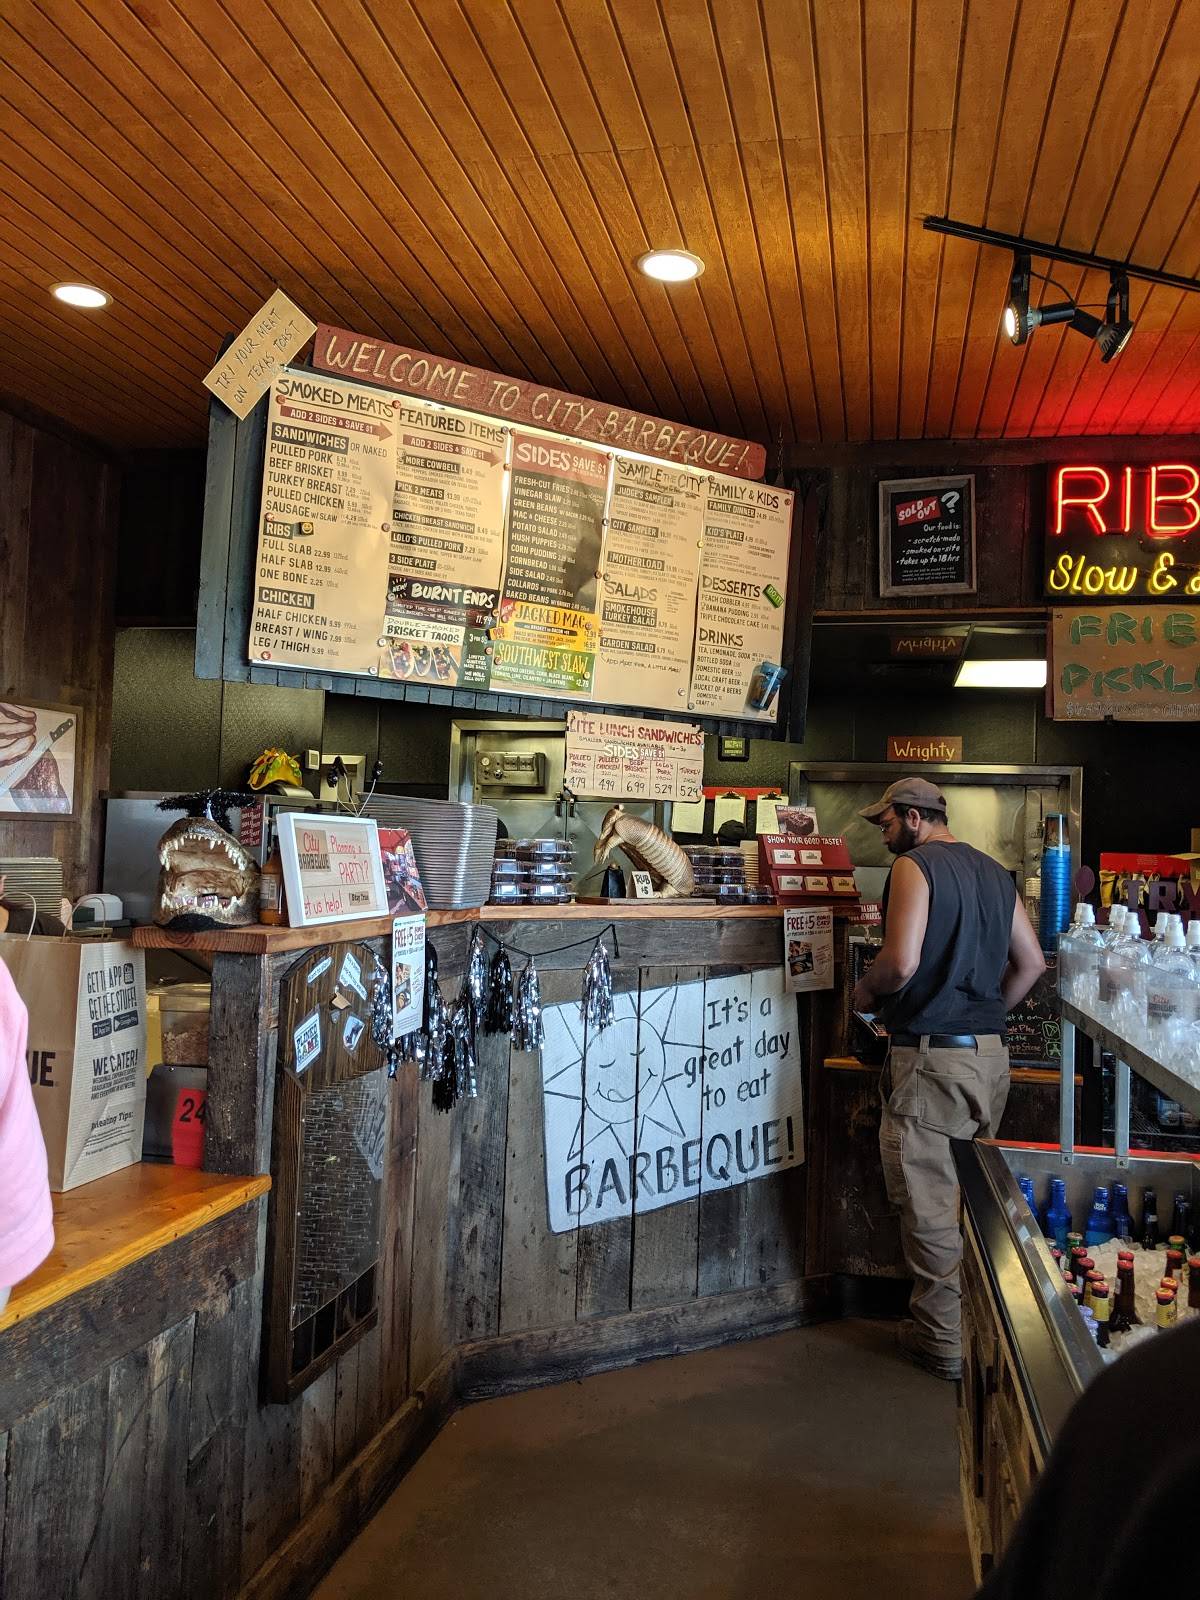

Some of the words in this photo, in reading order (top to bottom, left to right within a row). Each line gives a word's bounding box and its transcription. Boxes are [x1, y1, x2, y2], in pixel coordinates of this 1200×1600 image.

[215, 366, 236, 393] TRY
[234, 338, 260, 366] YOUR
[256, 308, 282, 338] MEAT
[234, 387, 247, 404] ON
[248, 354, 275, 386] TEXAS
[273, 320, 302, 352] TOAST
[276, 380, 343, 404] SMOKED
[347, 394, 393, 417] MEATS
[325, 335, 479, 398] WELCOME
[488, 380, 520, 412] TO
[532, 393, 594, 432] CITY
[599, 411, 749, 470] BARBEQUE!
[400, 408, 466, 433] FEATURED
[469, 421, 505, 444] ITEMS
[275, 425, 347, 449] SANDWICHES
[350, 442, 360, 453] OR
[362, 443, 387, 458] NAKED
[270, 443, 306, 458] PULLED
[309, 451, 333, 465] PORK
[405, 456, 426, 468] MORE
[427, 460, 459, 473] COWBELL
[516, 443, 571, 472] SIDES
[572, 455, 595, 473] SAVE
[597, 462, 606, 475] $1
[268, 471, 305, 487] TURKEY
[307, 479, 343, 495] BREAST
[514, 475, 551, 490] FRESH-CUT
[553, 482, 570, 494] FRIES
[617, 461, 663, 482] SAMPLE
[677, 474, 701, 492] CITY
[514, 487, 543, 500] VINEGAR
[545, 492, 562, 503] SLAW
[708, 481, 747, 500] FAMILY
[748, 490, 755, 500] &
[756, 490, 780, 509] KIDS
[265, 500, 310, 518] SAUSAGE
[320, 512, 338, 523] SLAW
[898, 500, 923, 521] SOLD
[917, 500, 937, 519] OUT
[266, 522, 291, 538] RIBS
[512, 520, 536, 533] POTATO
[538, 526, 558, 538] SALAD
[612, 520, 626, 530] CITY
[627, 523, 657, 536] SAMPLER
[923, 523, 936, 532] Our
[937, 521, 953, 531] food
[262, 538, 285, 552] FULL
[288, 542, 312, 556] SLAB
[314, 549, 331, 558] 22.99
[906, 545, 932, 554] smoked
[933, 544, 960, 553] on-site
[913, 533, 960, 544] scratch-made
[510, 555, 547, 569] CORNBREAD
[900, 557, 919, 565] takes
[920, 557, 928, 565] up
[929, 555, 937, 563] to
[938, 554, 946, 562] 18
[947, 554, 960, 562] hrs
[1050, 555, 1137, 592] Slow
[1152, 552, 1178, 591] &
[507, 578, 540, 591] COLLARDS
[605, 581, 657, 601] SALADS
[702, 574, 760, 598] DESSERTS
[262, 589, 312, 608] CHICKEN
[411, 582, 463, 605] BURNT
[463, 589, 496, 609] ENDS
[506, 590, 527, 600] BAKED
[528, 592, 549, 604] BEANS
[515, 605, 561, 627] JACKED
[563, 614, 585, 629] MAC
[604, 611, 631, 623] TURKEY
[632, 615, 656, 627] SALAD
[605, 602, 656, 617] SMOKEHOUSE
[386, 624, 427, 639] BRISKET
[699, 627, 744, 647] DRINKS
[498, 643, 560, 670] SOUTHWEST
[562, 653, 588, 674] SLAW
[1062, 660, 1200, 697] PICKL
[569, 718, 595, 735] LITE
[600, 722, 635, 739] LUNCH
[638, 726, 702, 746] SANDWICHES
[894, 741, 955, 762] Wrighty
[569, 777, 586, 789] 4.79
[599, 779, 615, 791] 4.99
[655, 784, 672, 795] 5.29
[303, 831, 320, 853] City
[767, 836, 785, 844] SHOW
[787, 836, 803, 845] YOUR
[804, 837, 820, 845] GOOD
[821, 838, 843, 846] TASTE!
[338, 860, 369, 884] PARTY?
[634, 874, 650, 884] RUB
[304, 895, 313, 916] et
[314, 899, 323, 914] us
[324, 890, 344, 914] help!
[787, 915, 804, 931] FREE
[109, 964, 122, 986] APP
[116, 985, 138, 1011] STUFF!
[707, 996, 748, 1030] It's
[760, 997, 772, 1017] a
[93, 1055, 109, 1077] WE
[109, 1048, 139, 1073] CATER!
[684, 1035, 744, 1088] great
[755, 1030, 790, 1060] day
[703, 1083, 726, 1112] to
[737, 1068, 771, 1103] eat
[565, 1115, 795, 1217] BARBEQUE!
